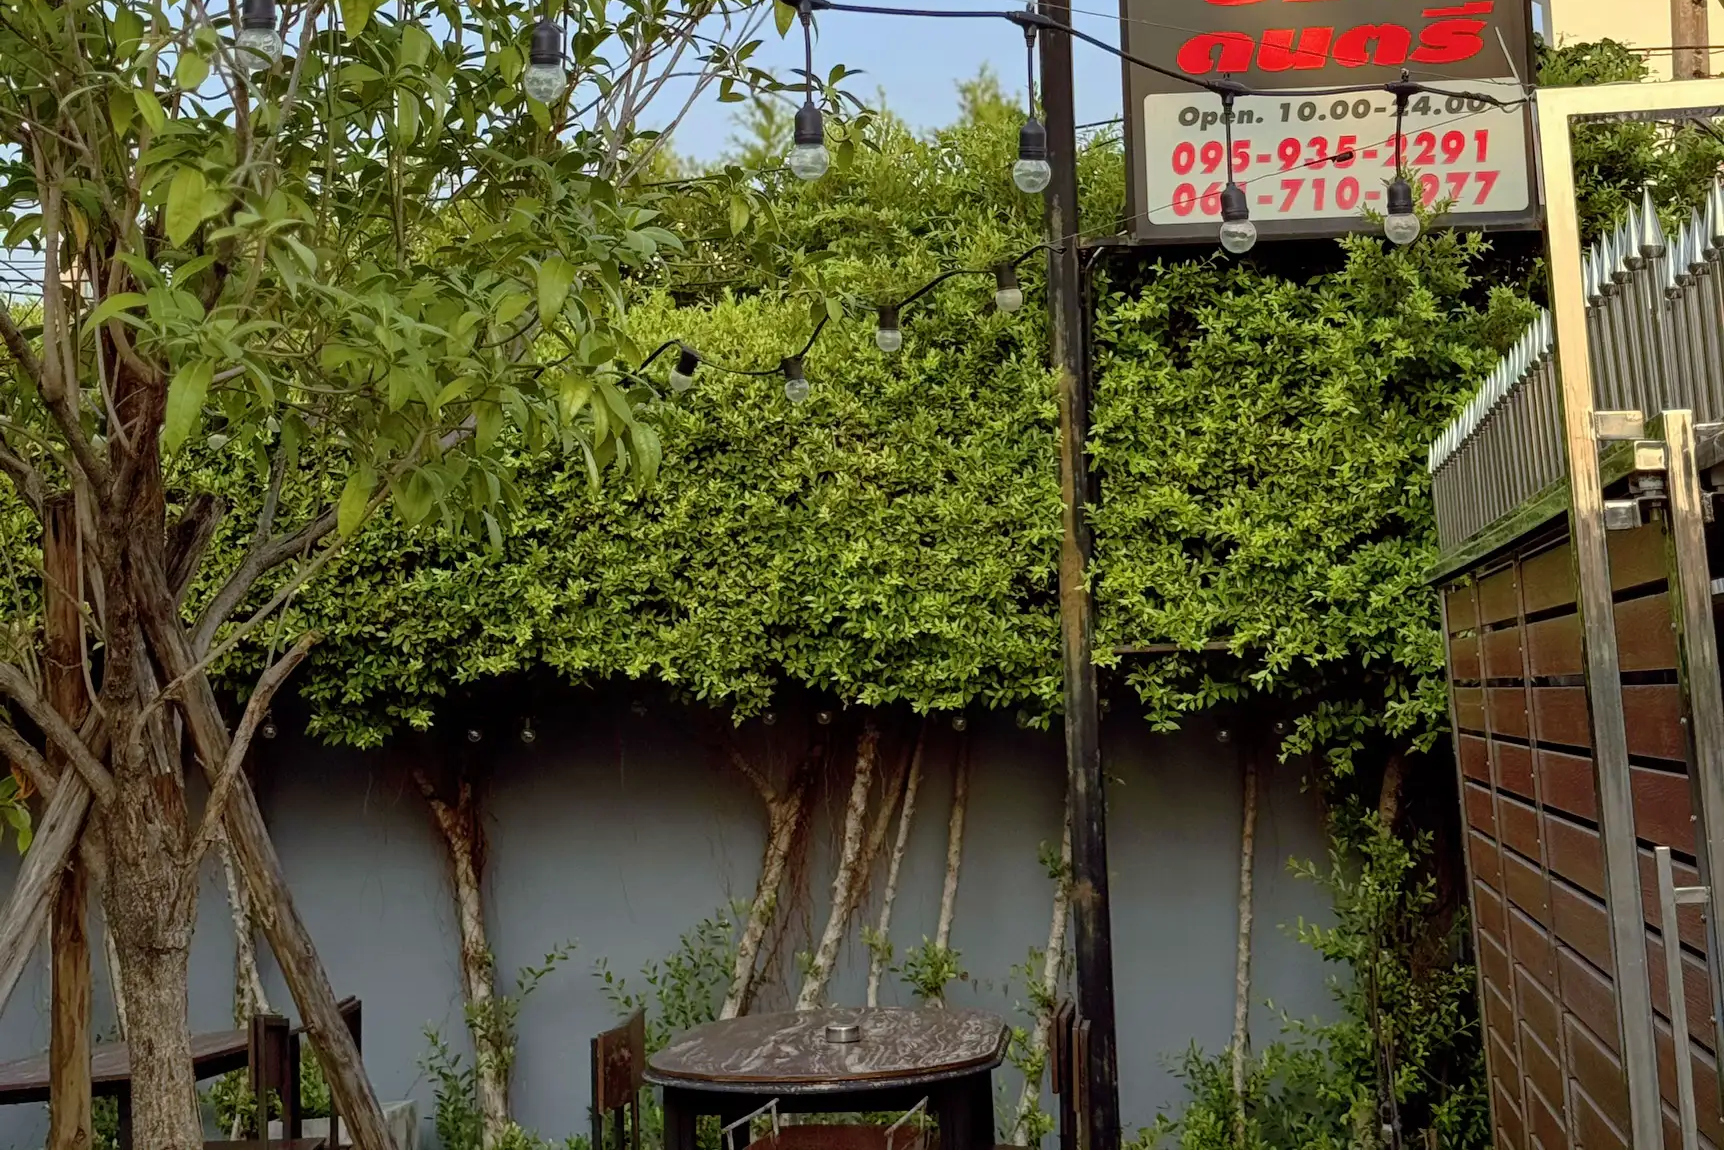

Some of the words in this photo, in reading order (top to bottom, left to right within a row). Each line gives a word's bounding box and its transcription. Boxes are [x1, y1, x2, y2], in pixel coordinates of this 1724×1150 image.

[1176, 0, 1494, 74] ดนตรี
[1171, 129, 1489, 176] 095-935-2291
[1172, 170, 1500, 217] 06-710-977
